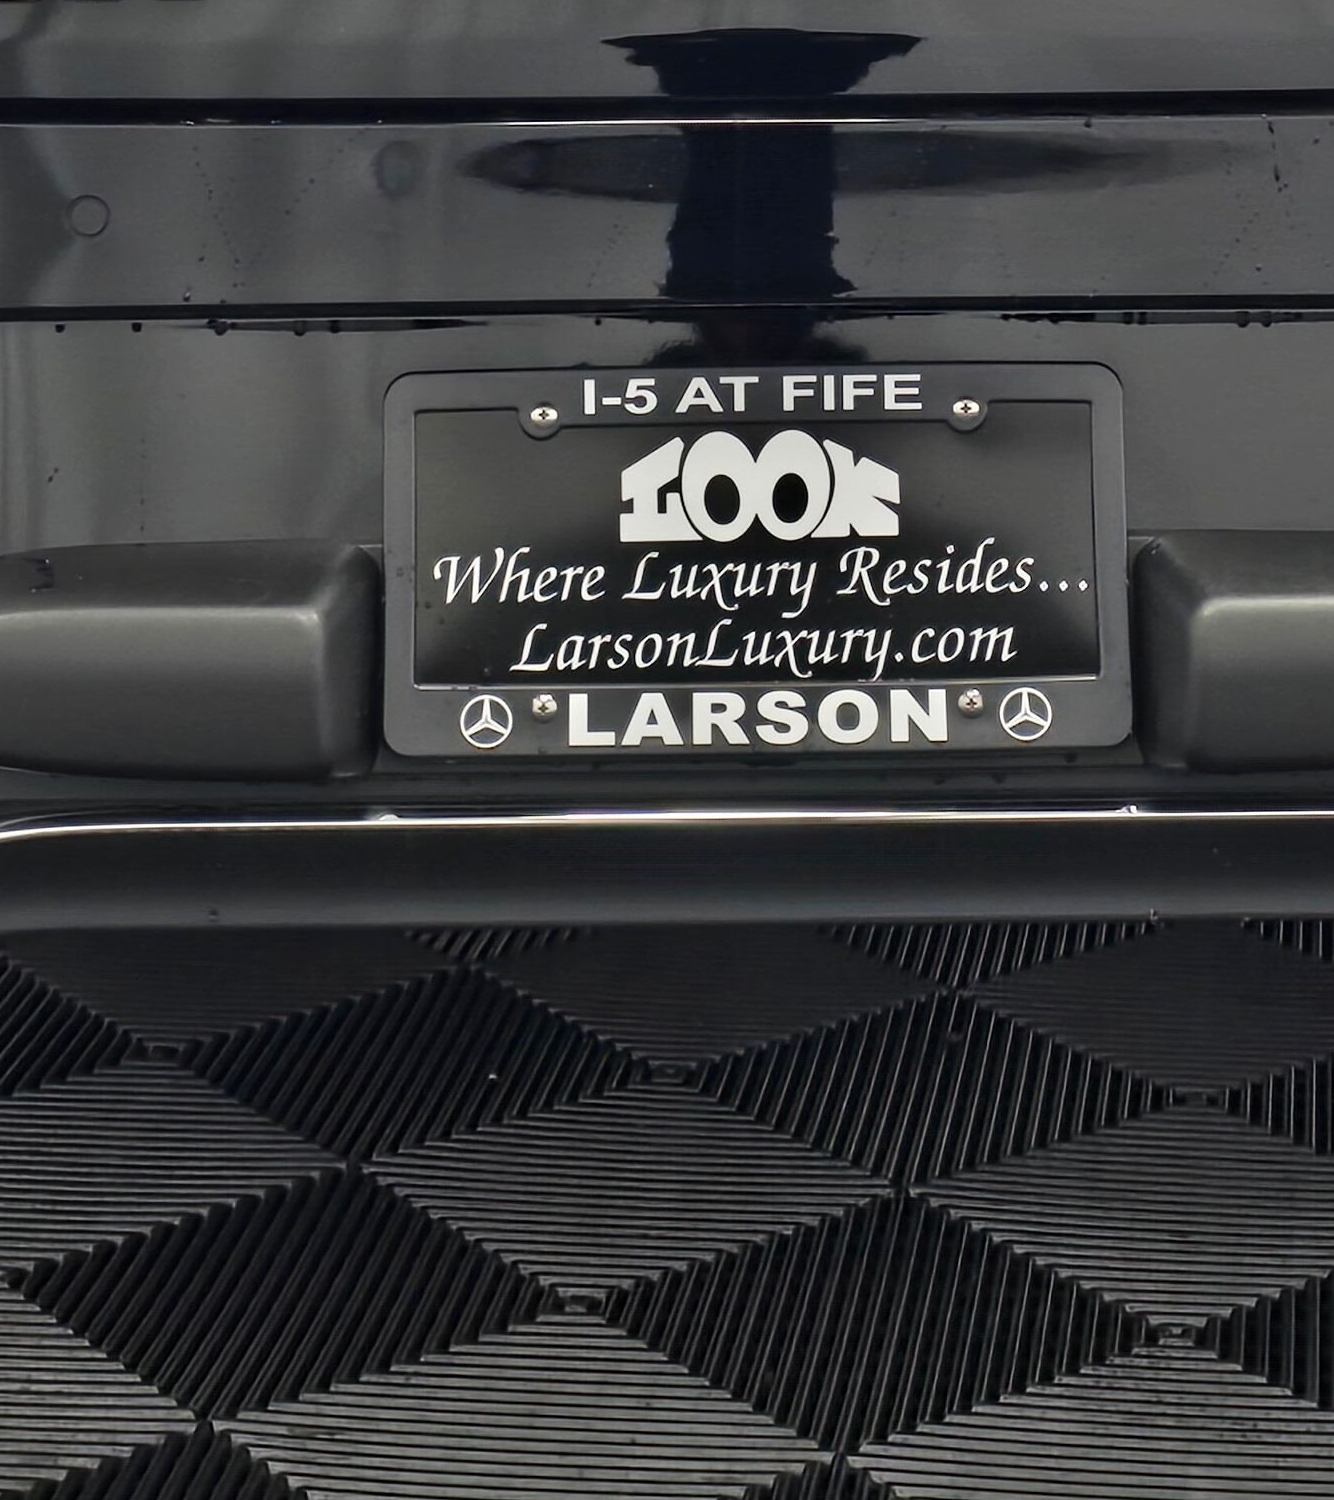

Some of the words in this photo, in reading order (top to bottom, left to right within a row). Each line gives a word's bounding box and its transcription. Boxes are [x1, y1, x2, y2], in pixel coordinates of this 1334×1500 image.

[582, 378, 658, 415] I-5
[676, 376, 758, 413] AT
[782, 373, 924, 411] FIFE
[433, 546, 606, 605] Where
[622, 551, 818, 618] Luxury
[837, 537, 1089, 607] Resides...
[509, 618, 1017, 682] LarsonLuxury.com
[567, 688, 949, 747] LARSON
